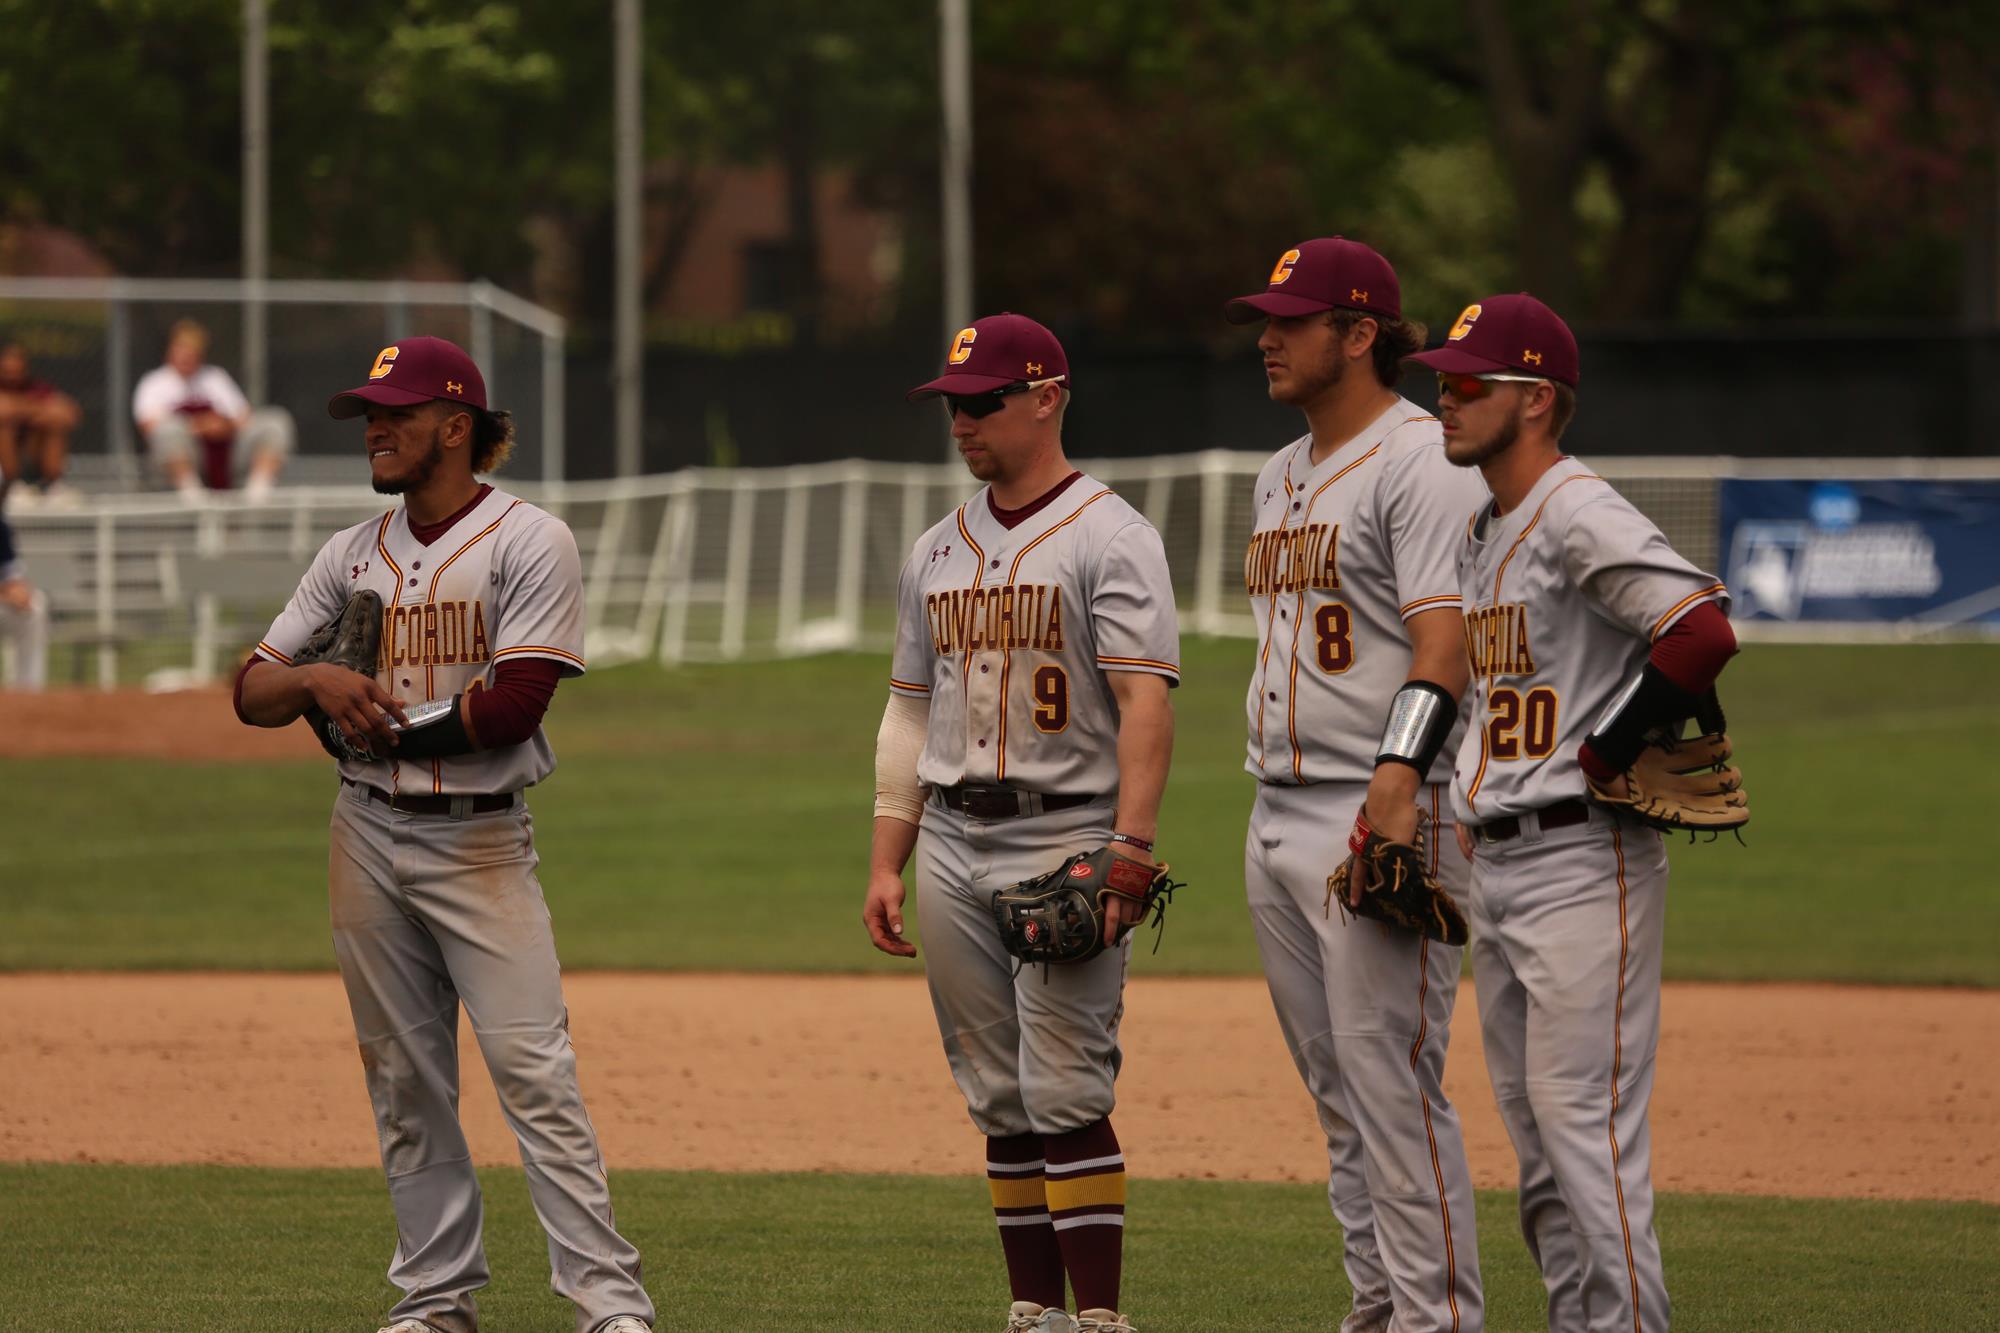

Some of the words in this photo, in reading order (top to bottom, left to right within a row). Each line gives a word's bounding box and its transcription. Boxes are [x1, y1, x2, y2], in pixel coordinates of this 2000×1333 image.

[1270, 249, 1300, 285] C
[949, 327, 977, 365] C
[1448, 304, 1482, 340] C
[369, 346, 400, 379] C
[378, 600, 491, 672] NCORDIA
[927, 583, 1064, 656] CONCORDIA
[1314, 601, 1355, 674] 8
[1032, 664, 1070, 734] 9
[1488, 686, 1559, 760] 20
